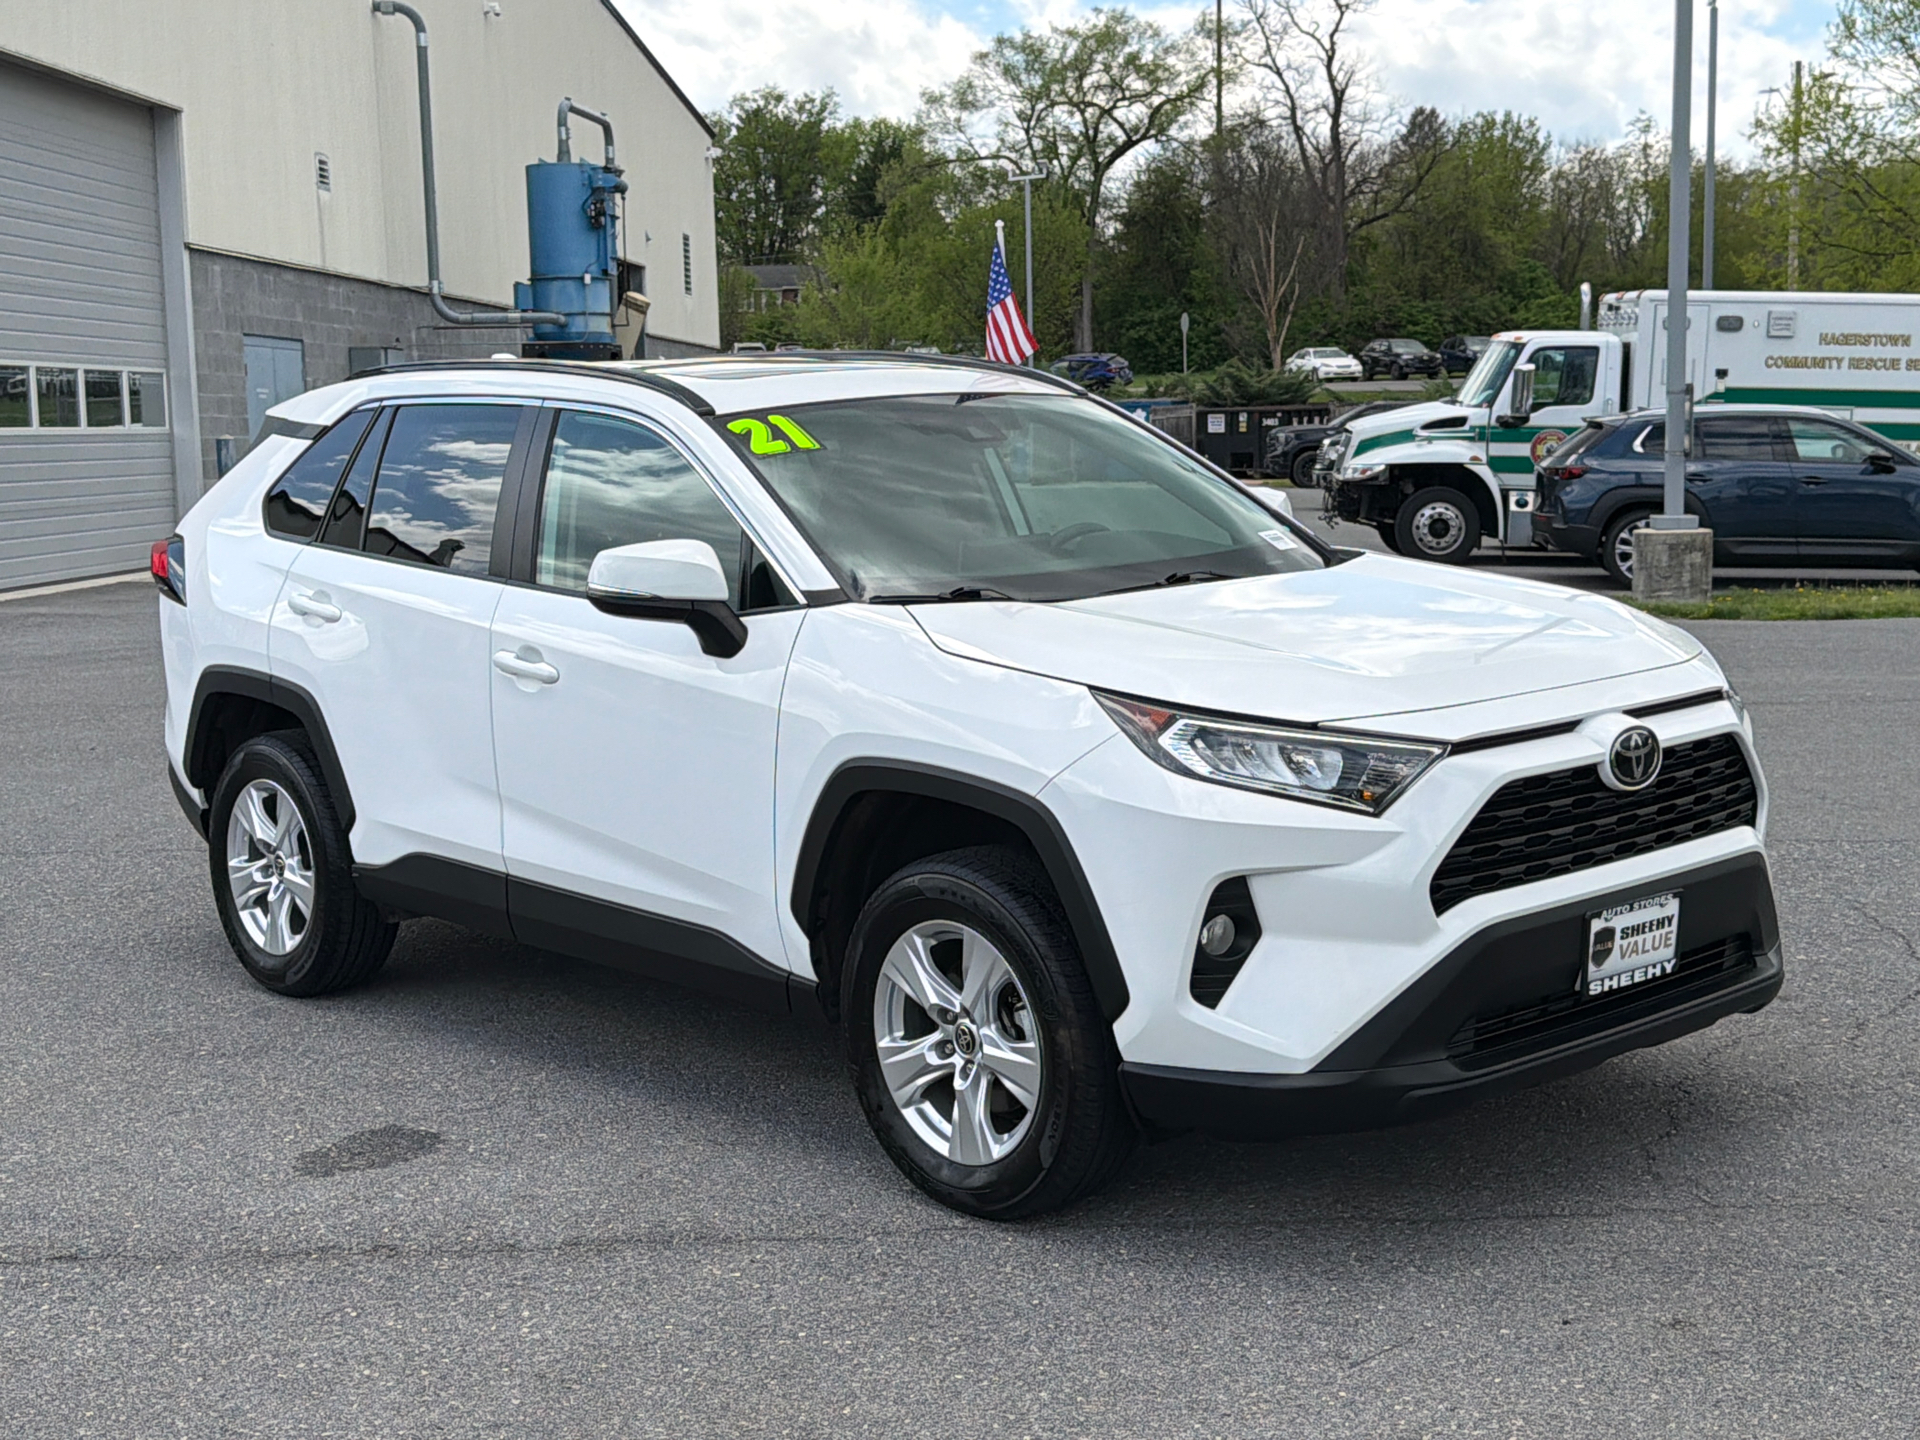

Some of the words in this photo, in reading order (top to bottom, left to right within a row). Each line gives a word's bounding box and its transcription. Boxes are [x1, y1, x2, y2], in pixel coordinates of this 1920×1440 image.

[1818, 332, 1912, 347] HAGERSTOWN
[1765, 355, 1845, 370] COMMUNITY
[1848, 356, 1902, 371] RESCUE
[726, 414, 821, 455] 21
[1602, 904, 1631, 918] AUTO
[1633, 893, 1674, 911] STORES
[1620, 914, 1675, 940] SHEEHY
[1619, 930, 1674, 960] VALUE
[1588, 959, 1676, 996] SHEEHY
